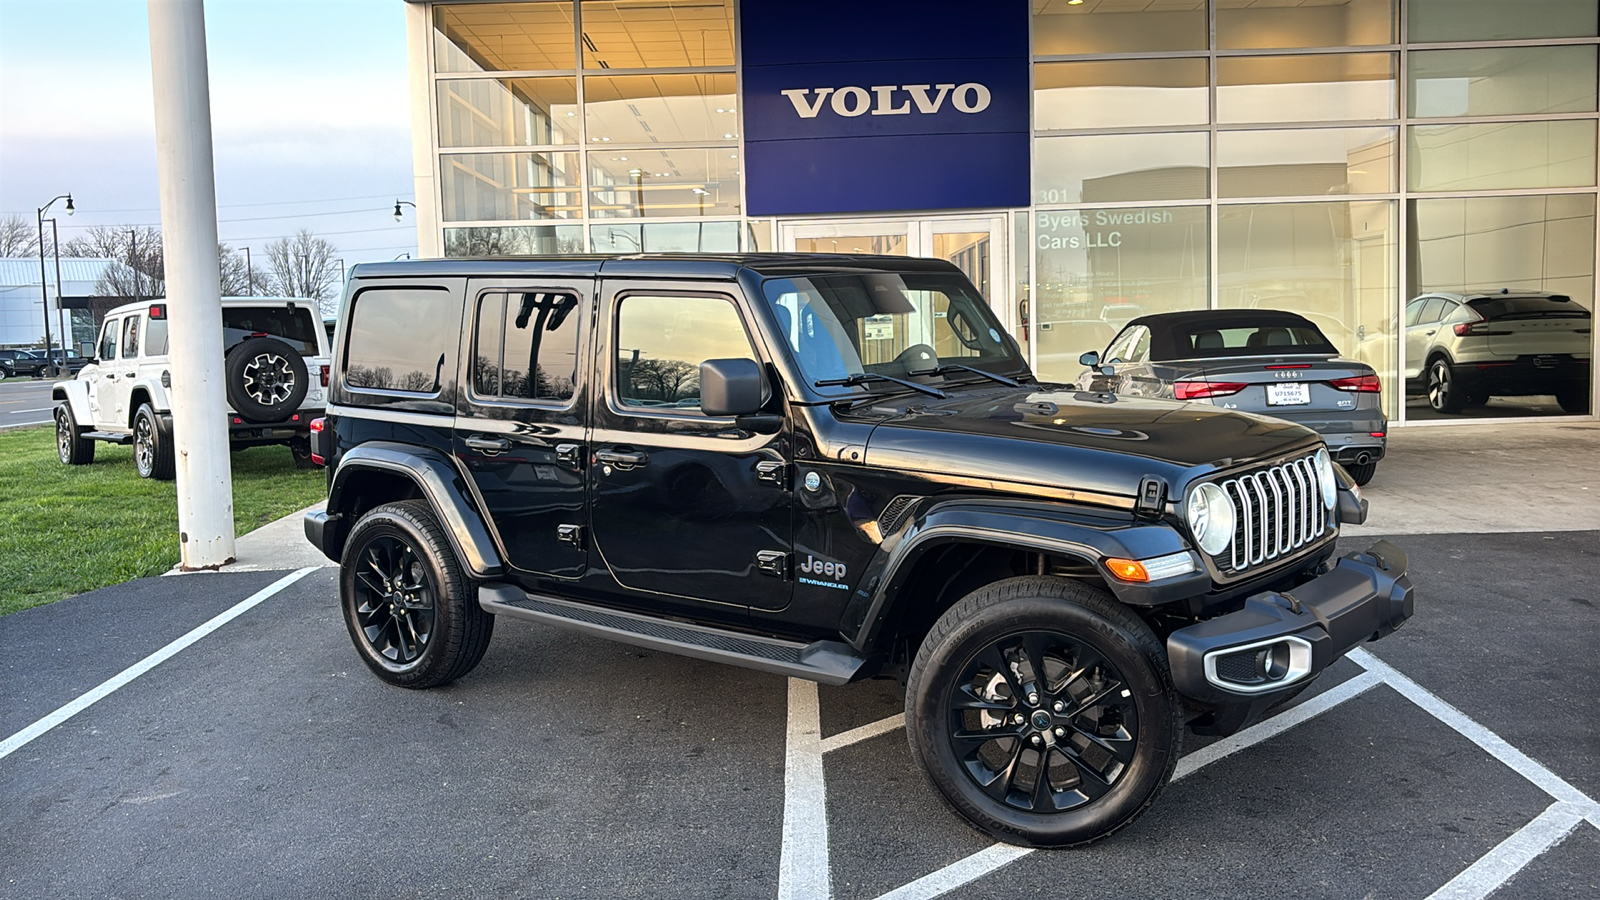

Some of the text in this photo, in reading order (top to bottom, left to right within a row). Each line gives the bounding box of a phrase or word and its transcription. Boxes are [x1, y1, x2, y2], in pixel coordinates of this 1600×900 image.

[780, 82, 992, 119] VOLVO
[1038, 189, 1068, 204] 301
[1037, 212, 1090, 232] Byers
[1095, 209, 1173, 226] Swedish
[1037, 231, 1122, 250] Cars LLC
[800, 555, 847, 581] Jeep
[806, 578, 849, 590] WRANGLER
